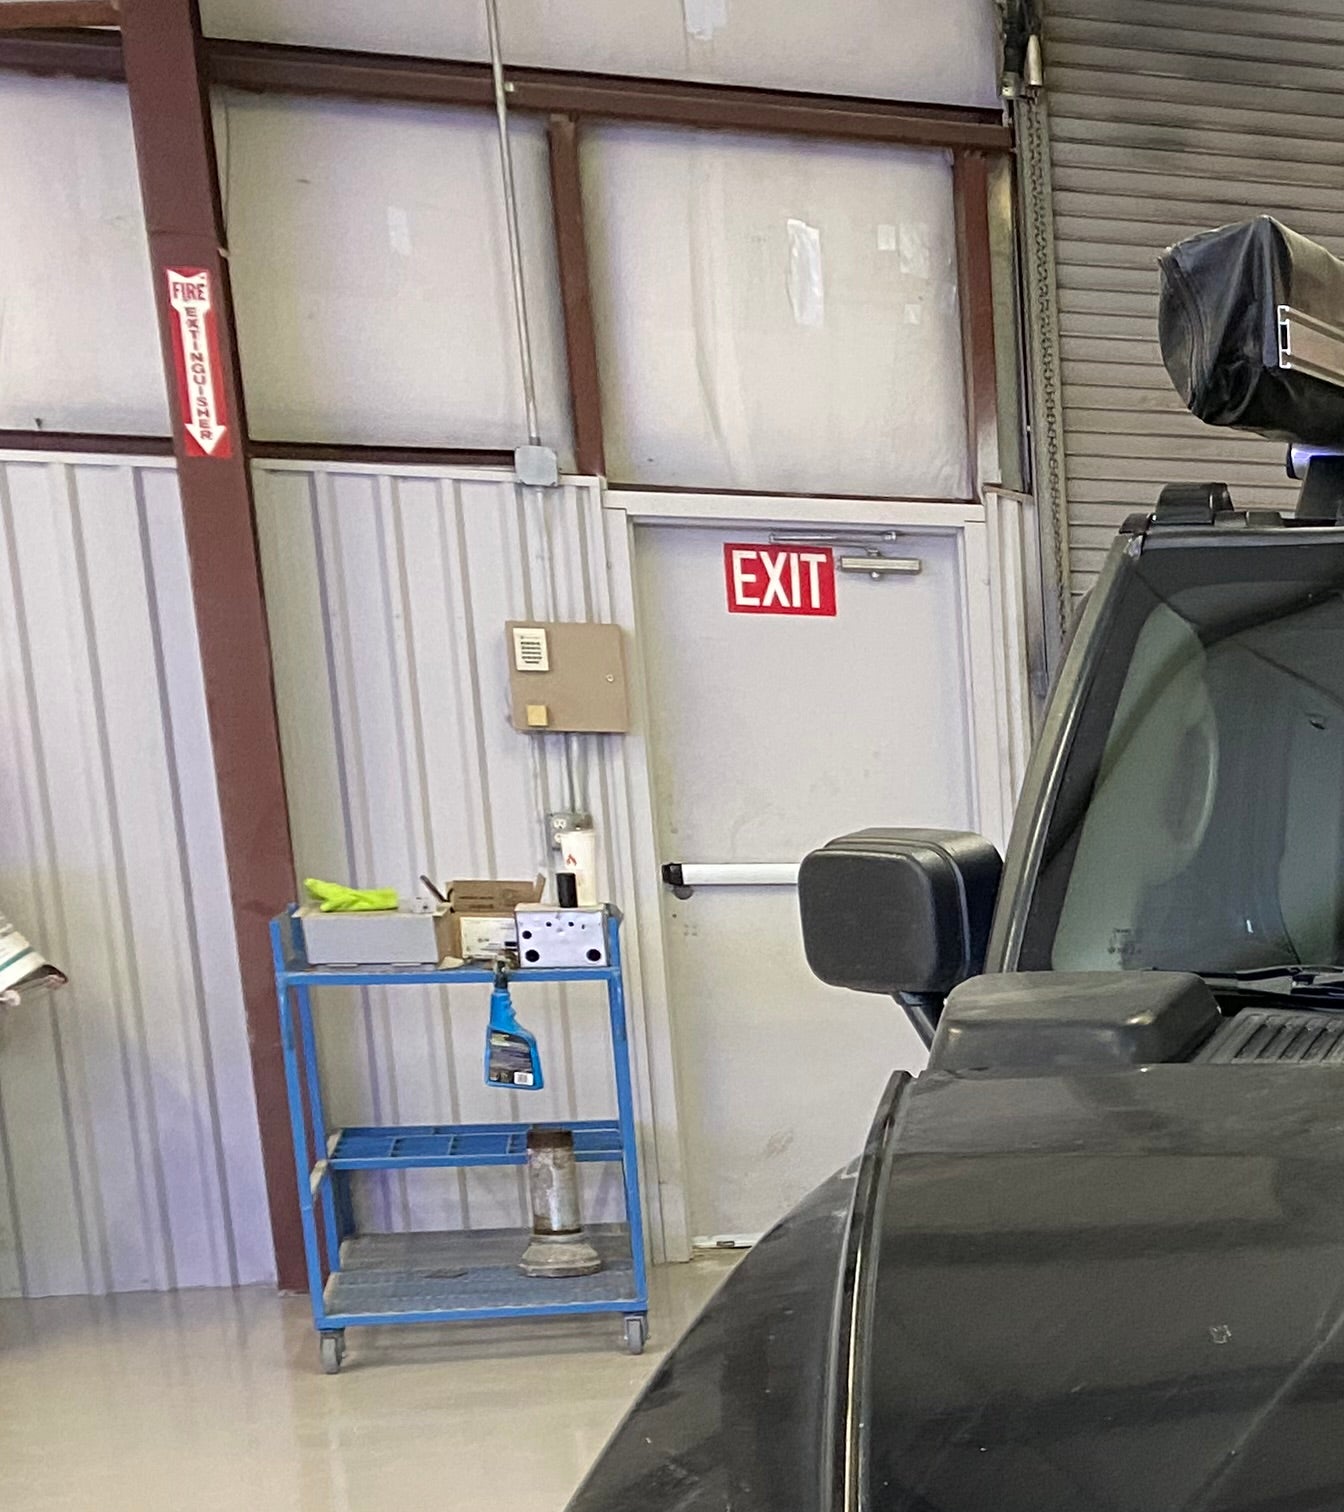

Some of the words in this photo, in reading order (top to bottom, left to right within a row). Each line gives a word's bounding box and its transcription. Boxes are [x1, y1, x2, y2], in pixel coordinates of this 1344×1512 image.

[173, 281, 206, 301] FIRE
[185, 307, 213, 441] EXTINGUISHER
[732, 549, 827, 609] EXIT
